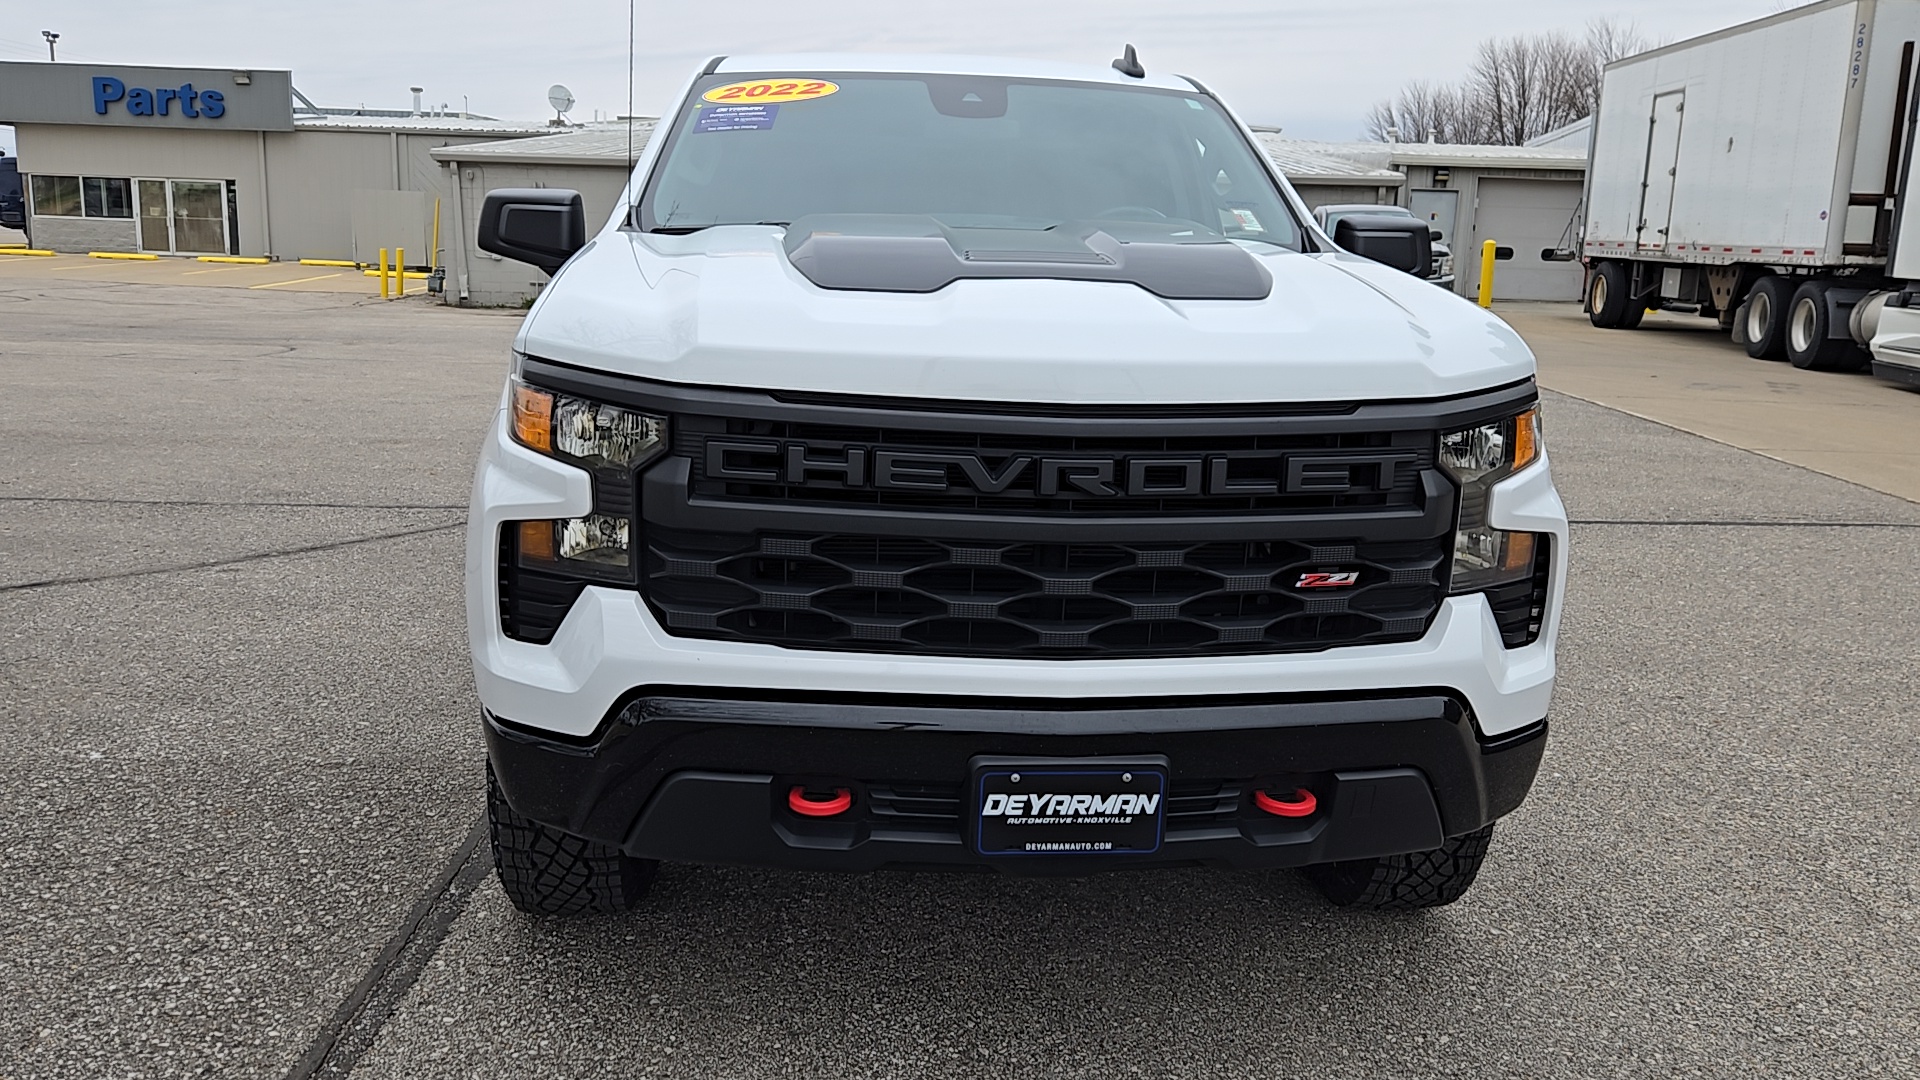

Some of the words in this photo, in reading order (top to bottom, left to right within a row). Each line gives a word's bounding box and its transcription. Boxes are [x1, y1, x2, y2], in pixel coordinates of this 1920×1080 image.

[1851, 23, 1866, 88] 28287
[92, 76, 225, 118] Parts
[716, 82, 826, 100] 2022
[706, 441, 1417, 496] CHEVROLET
[1295, 572, 1360, 587] Z71
[982, 794, 1160, 816] DEYARMAN
[1025, 842, 1112, 851] DEYARMANAUTO.COM
